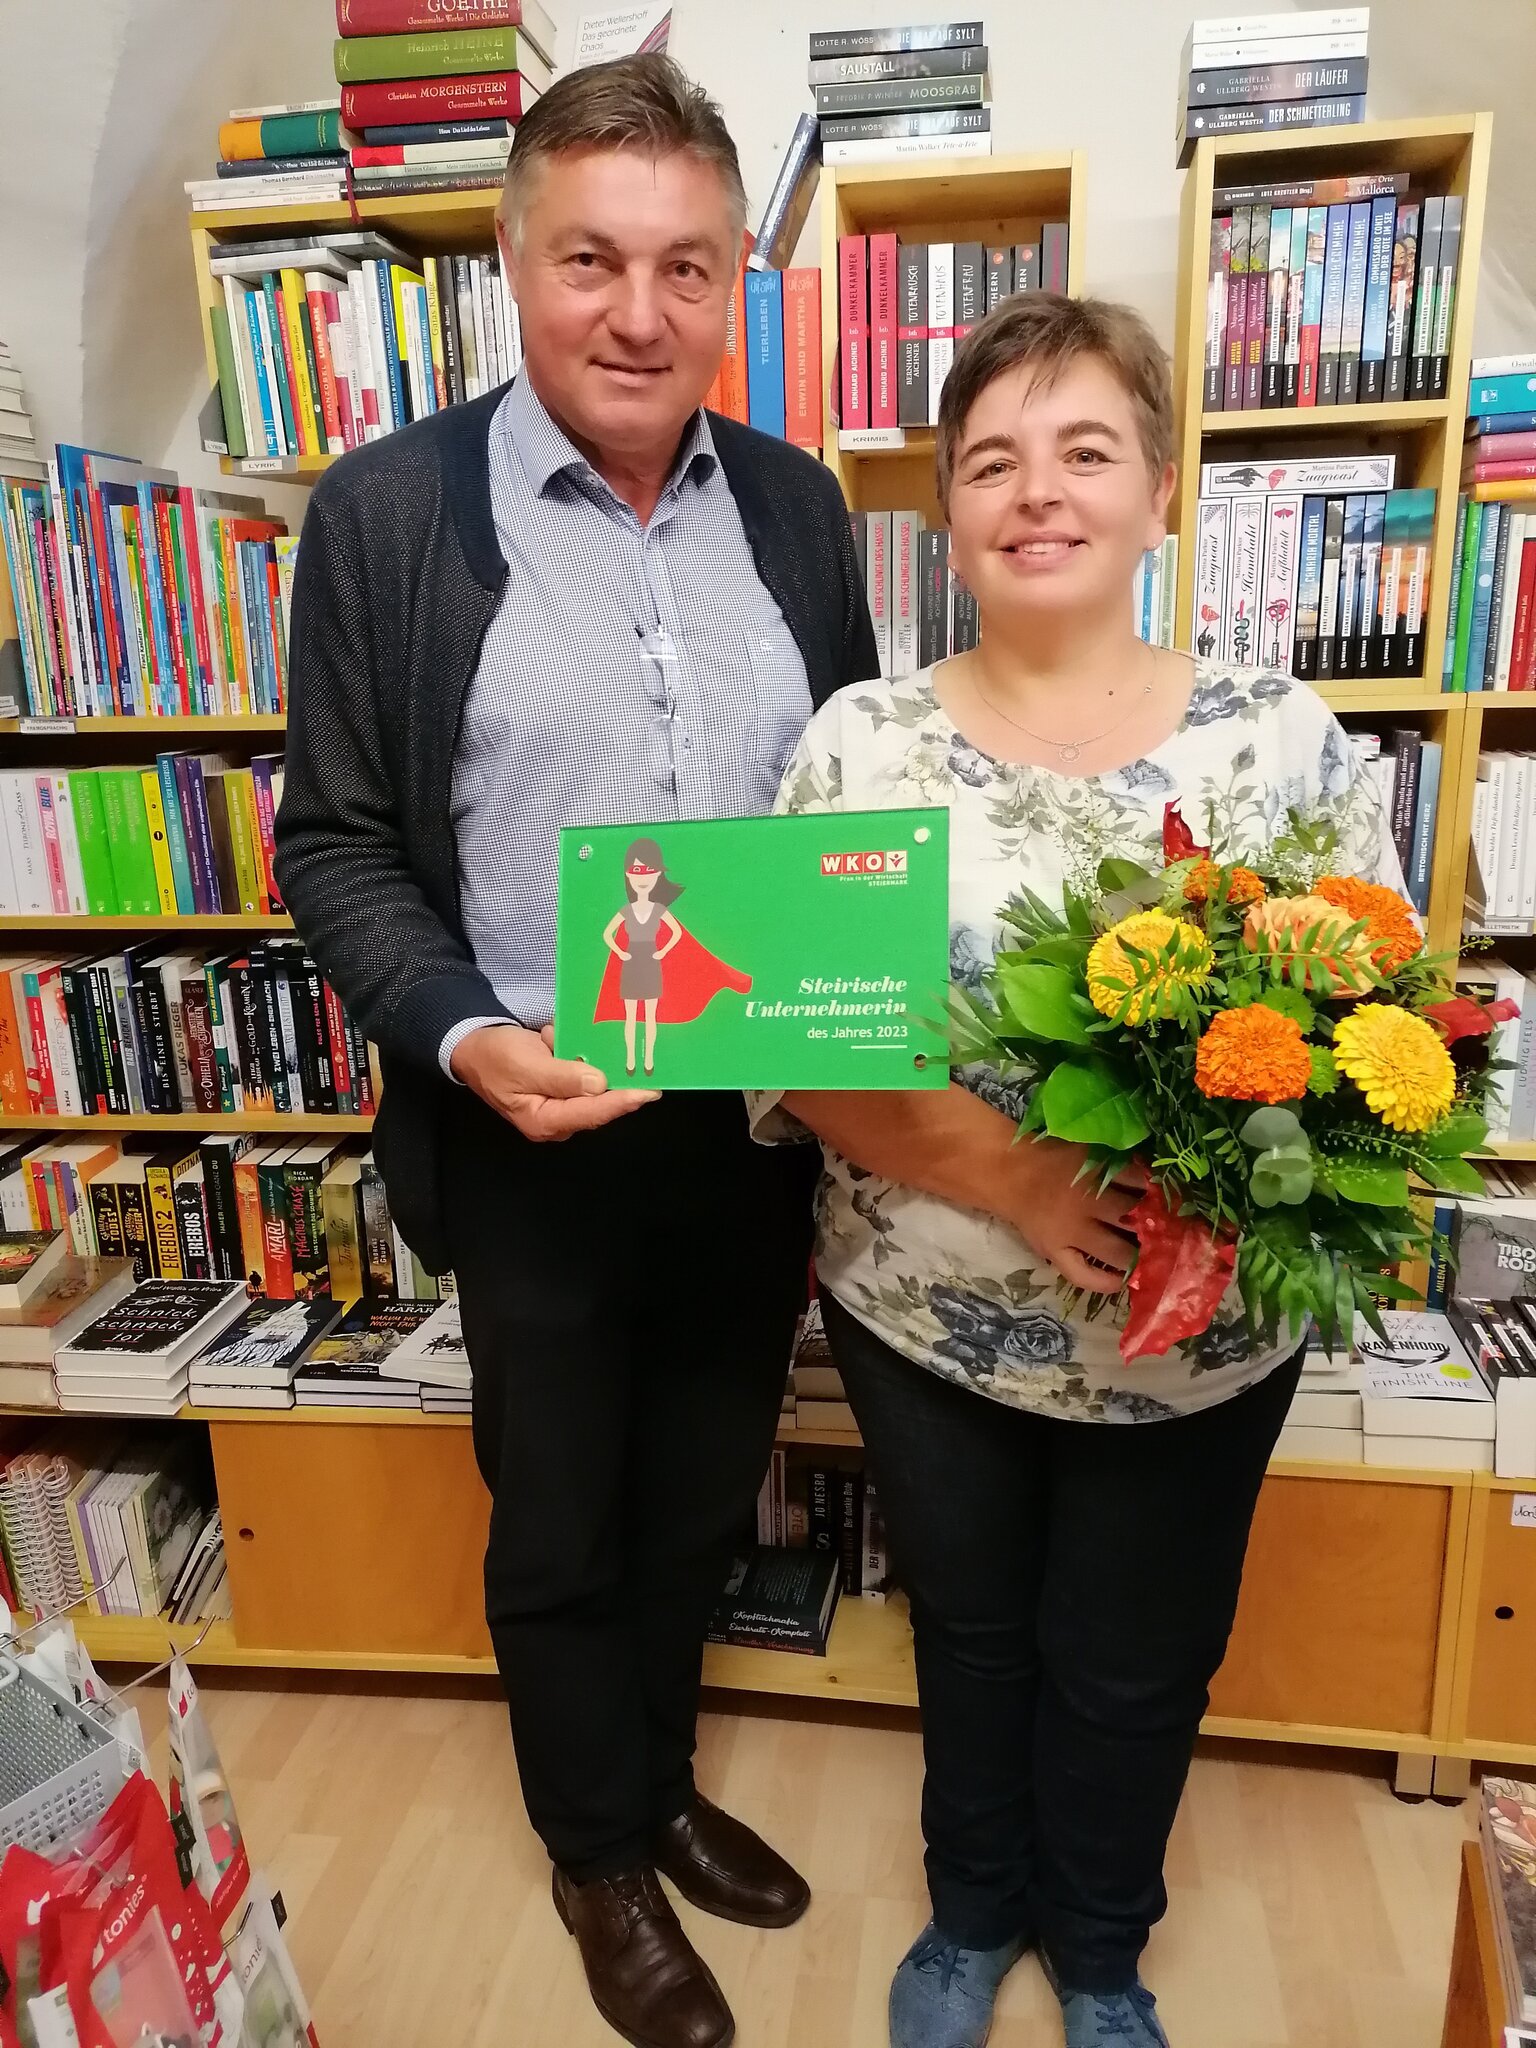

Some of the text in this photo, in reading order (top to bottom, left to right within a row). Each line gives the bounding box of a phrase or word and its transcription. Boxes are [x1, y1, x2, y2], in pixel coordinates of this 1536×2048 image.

[582, 24, 637, 42] Das geordnete
[583, 20, 606, 31] Dieter
[815, 28, 976, 47] LOTTE SYLT
[408, 39, 449, 53] Heinrich
[580, 42, 604, 53] Chaos
[840, 60, 895, 76] SAUSTALL
[1228, 75, 1271, 85] GABRIELLA
[1295, 68, 1349, 88] DER LÄUFER
[387, 81, 507, 101] Christian MORGENSTERN
[909, 85, 977, 99] MOOSGRAB
[1216, 82, 1283, 95] ULLBERG WESTIN
[825, 115, 983, 134] LOTTE SYLT
[1208, 118, 1265, 129] ULLBERG WESTIN
[1218, 111, 1255, 121] GABRIELLA
[1268, 102, 1351, 124] DER SCHMETTERLING
[1356, 184, 1395, 196] Mallorca
[1378, 174, 1395, 183] Orte
[1330, 219, 1344, 263] CRIMINAL
[1351, 218, 1366, 262] CRIMINAL
[1370, 214, 1384, 285] COMMISSARIO CONTI
[1379, 211, 1393, 286] UND DER TOTE SEE
[455, 262, 466, 283] fluss
[848, 251, 858, 322] DUNKELKAMMER
[879, 250, 889, 320] DUNKELKAMMER
[267, 282, 277, 331] ernst jandl
[426, 281, 438, 308] Klage
[908, 264, 919, 323] TOTENRAUSCH
[935, 265, 947, 322] TOTENHAUS
[963, 263, 974, 322] TOTENFRAU
[1238, 278, 1247, 323] Meisterwurz
[1257, 276, 1266, 322] Meisterwurz
[312, 306, 323, 334] PARK
[759, 298, 769, 366] TIERLEBEN
[377, 268, 401, 417] ATELIER GEORG BYDLINSKI LICHT
[796, 296, 808, 418] ERWIN UND MARTHA
[851, 341, 859, 374] AICHNER
[905, 343, 913, 386] BERNHARD
[912, 341, 920, 378] AICHNER
[880, 339, 888, 408] BERNHARD AICHNER
[852, 434, 889, 443] KRIMIS
[248, 461, 276, 469] LYRIK
[1305, 513, 1320, 583] CANARIA MORTAL
[1485, 508, 1499, 562] HEMINGWAY
[874, 522, 884, 609] DER SCHLINGE HASSES
[901, 521, 910, 609] DER SCHLINGE HASSES
[878, 624, 886, 655] DUTZLER
[904, 624, 912, 655] DUTZLER
[139, 652, 147, 670] Franz
[161, 760, 173, 789] ERSCHOSSEN
[1397, 747, 1409, 809] Wanda andere
[15, 791, 25, 813] GLASS
[39, 786, 52, 808] BLUE
[1404, 786, 1412, 827] gefährliche
[44, 809, 57, 839] ROYAL
[1418, 802, 1432, 883] BRETONISCH MIT HERZ
[822, 853, 883, 874] WKO
[206, 970, 216, 999] AWESOME
[308, 974, 320, 997] GIRL
[798, 976, 907, 995] Steirische
[745, 998, 907, 1018] Unternehmerin
[149, 990, 170, 1089] BIS EINER STIRBT
[170, 1000, 189, 1076] LUKAS RIEGER
[246, 1024, 256, 1048] GOLD
[263, 980, 282, 1073] ZWEI LEBEN NACHT
[807, 1025, 908, 1039] des Jahres 2023
[54, 1017, 70, 1076] BITTERFROST
[63, 1090, 71, 1108] PIPER
[211, 1159, 227, 1235] IMMER GANZ DU
[107, 1211, 120, 1242] TODES
[134, 1212, 145, 1242] MAGIER
[184, 1212, 206, 1257] EREBOS
[289, 1185, 311, 1259] MAGNUS CHASE
[156, 1210, 180, 1269] EREBOS 2
[269, 1218, 286, 1262] AMARI
[371, 1237, 379, 1265] ANDREAS
[379, 1238, 387, 1264] GRUBER
[1436, 1265, 1448, 1293] MILENA
[95, 1319, 185, 1332] schnack,
[113, 1307, 198, 1319] Schnick,
[112, 1332, 145, 1342] tot
[1373, 1379, 1473, 1389] FINISH LINE
[1402, 1372, 1435, 1380] THE
[815, 1506, 826, 1518] JO
[844, 1481, 853, 1529] Der dunkle Bote
[869, 1555, 879, 1570] DER
[102, 1879, 146, 1945] tonies
